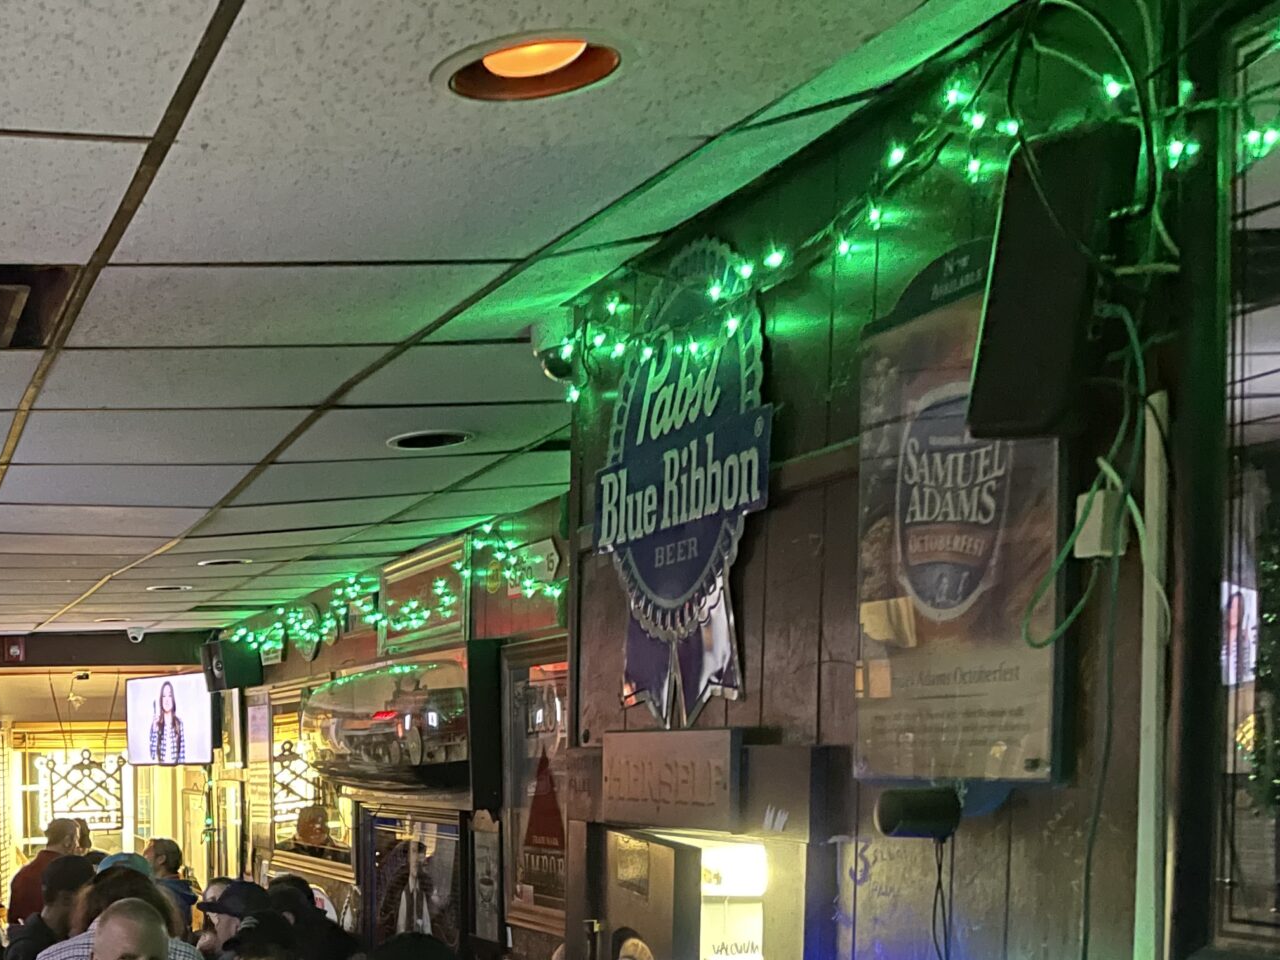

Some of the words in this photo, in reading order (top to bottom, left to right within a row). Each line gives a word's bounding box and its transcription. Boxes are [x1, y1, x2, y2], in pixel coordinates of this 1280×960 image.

[635, 331, 722, 447] Pabst
[904, 437, 1007, 489] SAMUEL
[598, 468, 658, 548] Blue
[660, 432, 761, 531] Ribbon
[905, 480, 998, 525] ADAMS
[654, 537, 699, 569] BEER
[908, 533, 986, 558] OCTOBERFEST
[606, 758, 724, 807] HERSELF
